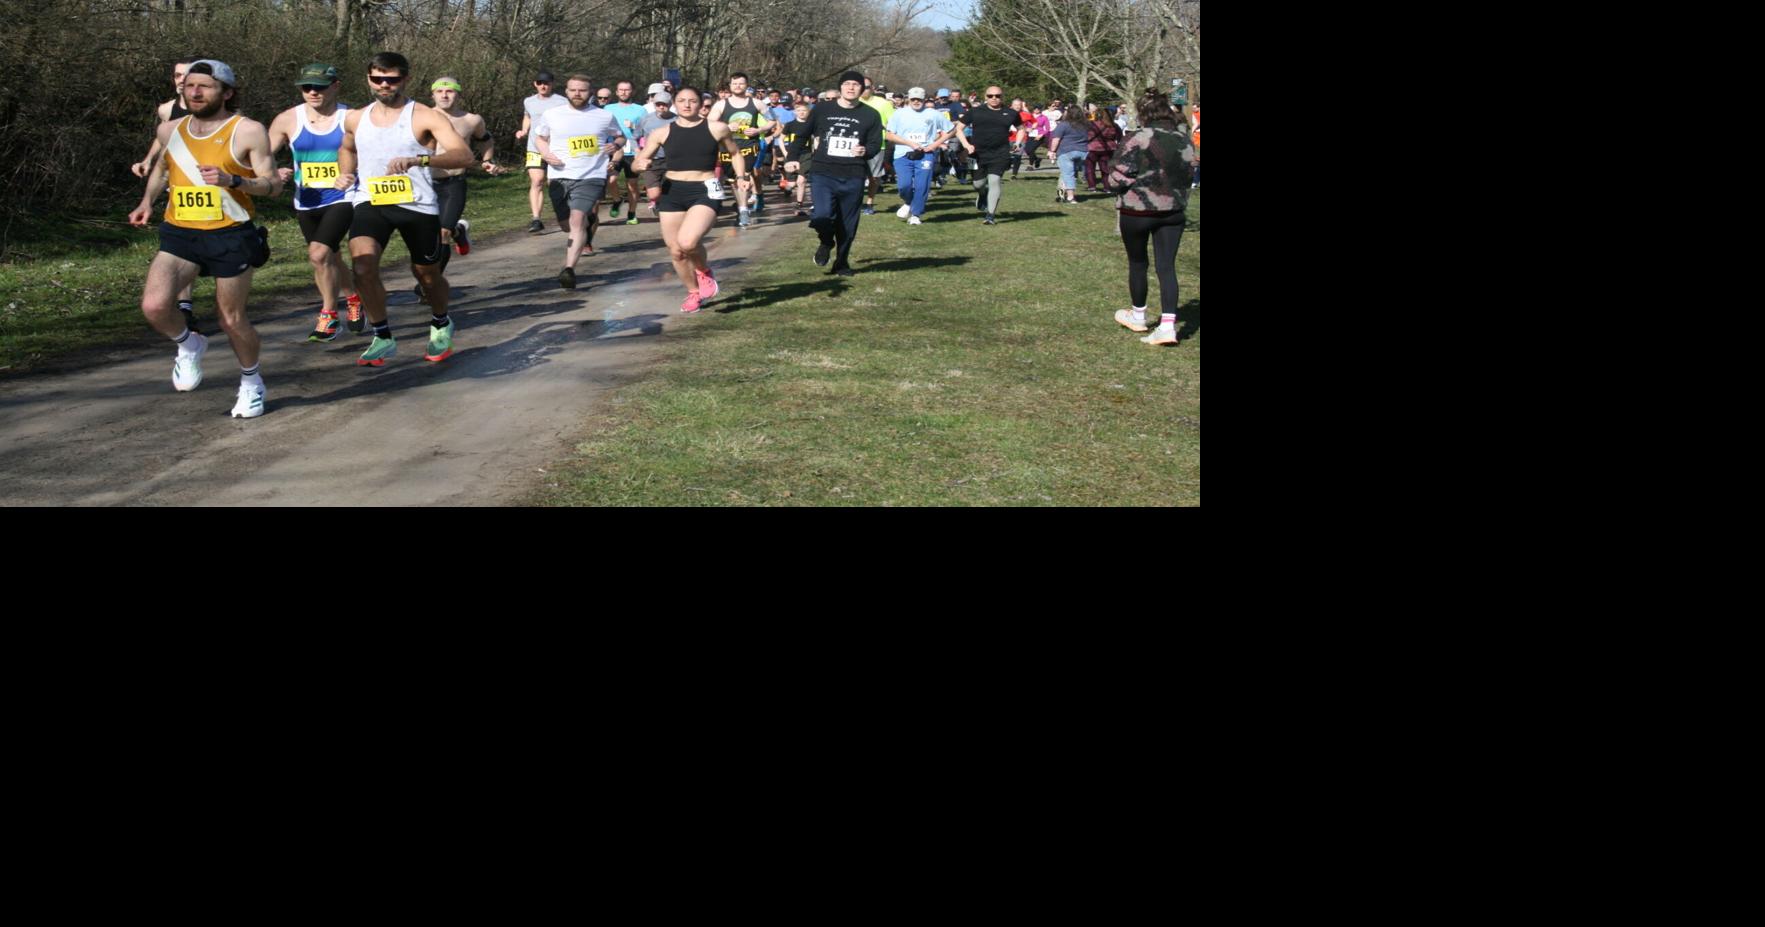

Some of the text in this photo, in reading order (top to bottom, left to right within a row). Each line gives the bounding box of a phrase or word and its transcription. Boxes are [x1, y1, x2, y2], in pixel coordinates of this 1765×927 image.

[571, 138, 594, 150] 1701
[834, 140, 852, 150] 131
[306, 166, 336, 178] 1736
[374, 179, 406, 194] 1660
[177, 191, 214, 207] 1661
